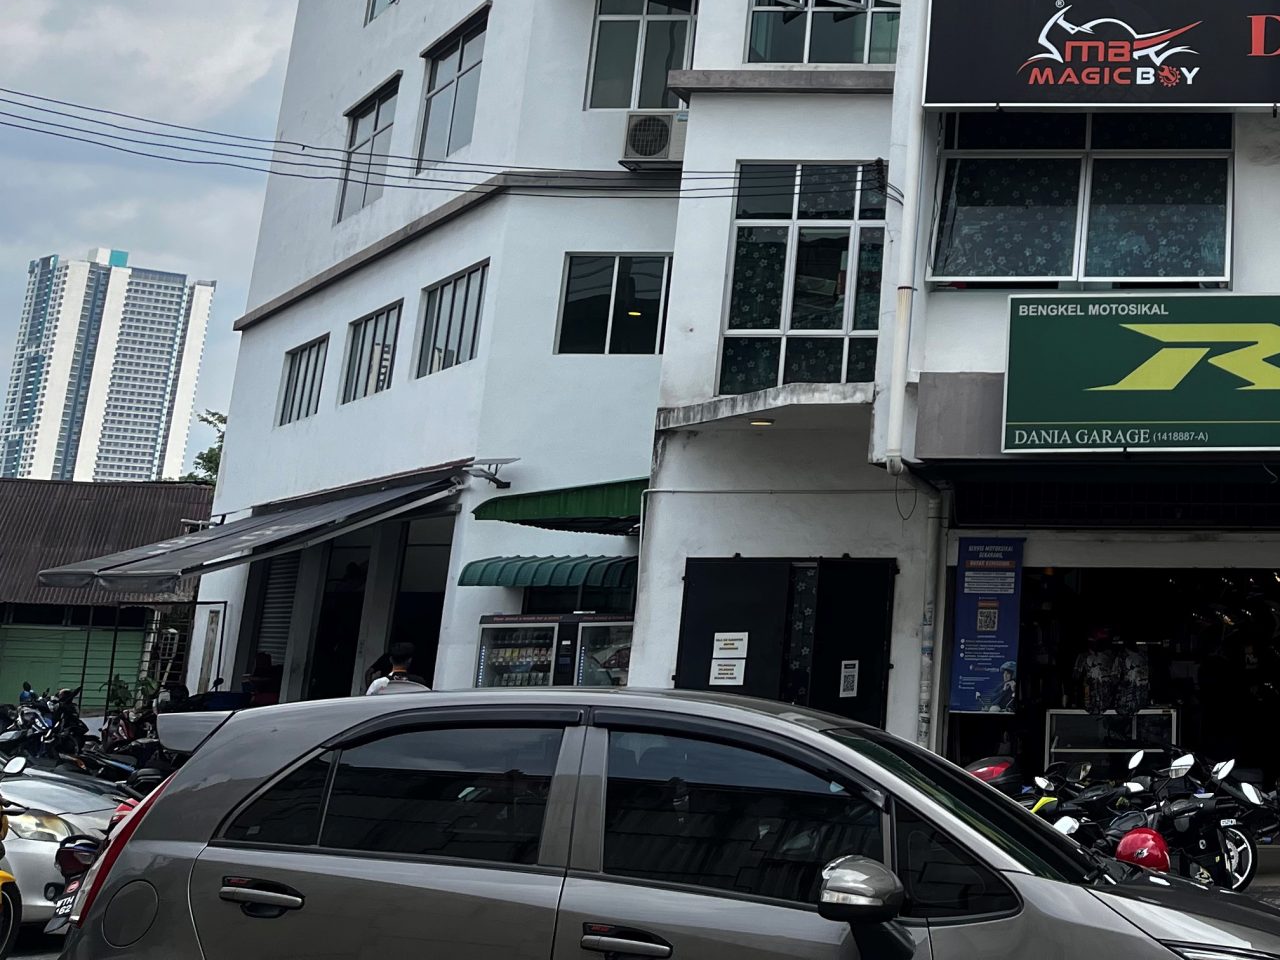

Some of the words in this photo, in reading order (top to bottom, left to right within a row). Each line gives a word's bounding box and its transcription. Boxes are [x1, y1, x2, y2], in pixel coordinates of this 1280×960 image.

[1018, 305, 1085, 316] BENGKEL
[1088, 304, 1169, 315] MOTOSIKAL
[1014, 430, 1072, 445] DANIA
[1075, 429, 1150, 444] GARAGE
[1153, 432, 1209, 442] (1418887-A)
